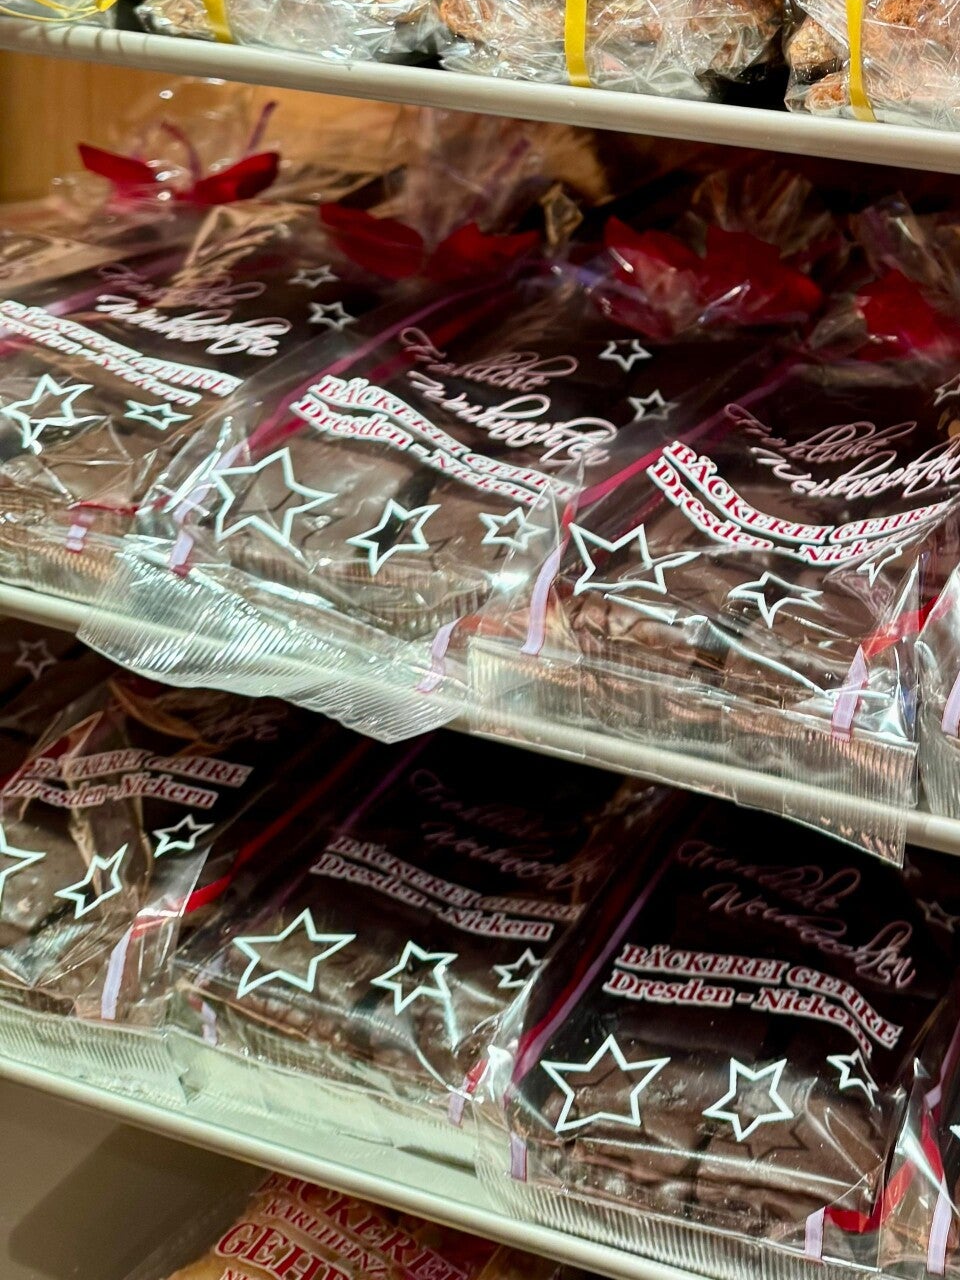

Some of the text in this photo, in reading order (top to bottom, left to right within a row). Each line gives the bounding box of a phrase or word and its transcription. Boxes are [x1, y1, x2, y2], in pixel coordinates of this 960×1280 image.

[289, 392, 414, 451] Dresden
[306, 374, 473, 458] BÄCKEREI
[645, 454, 774, 551] Dresden
[662, 440, 836, 546] BÄCKEREI
[113, 770, 220, 810] Nickern
[437, 905, 555, 942] Nickern
[602, 969, 736, 1008] Dresden
[614, 942, 904, 1051] BÄCKEREI GEHRE
